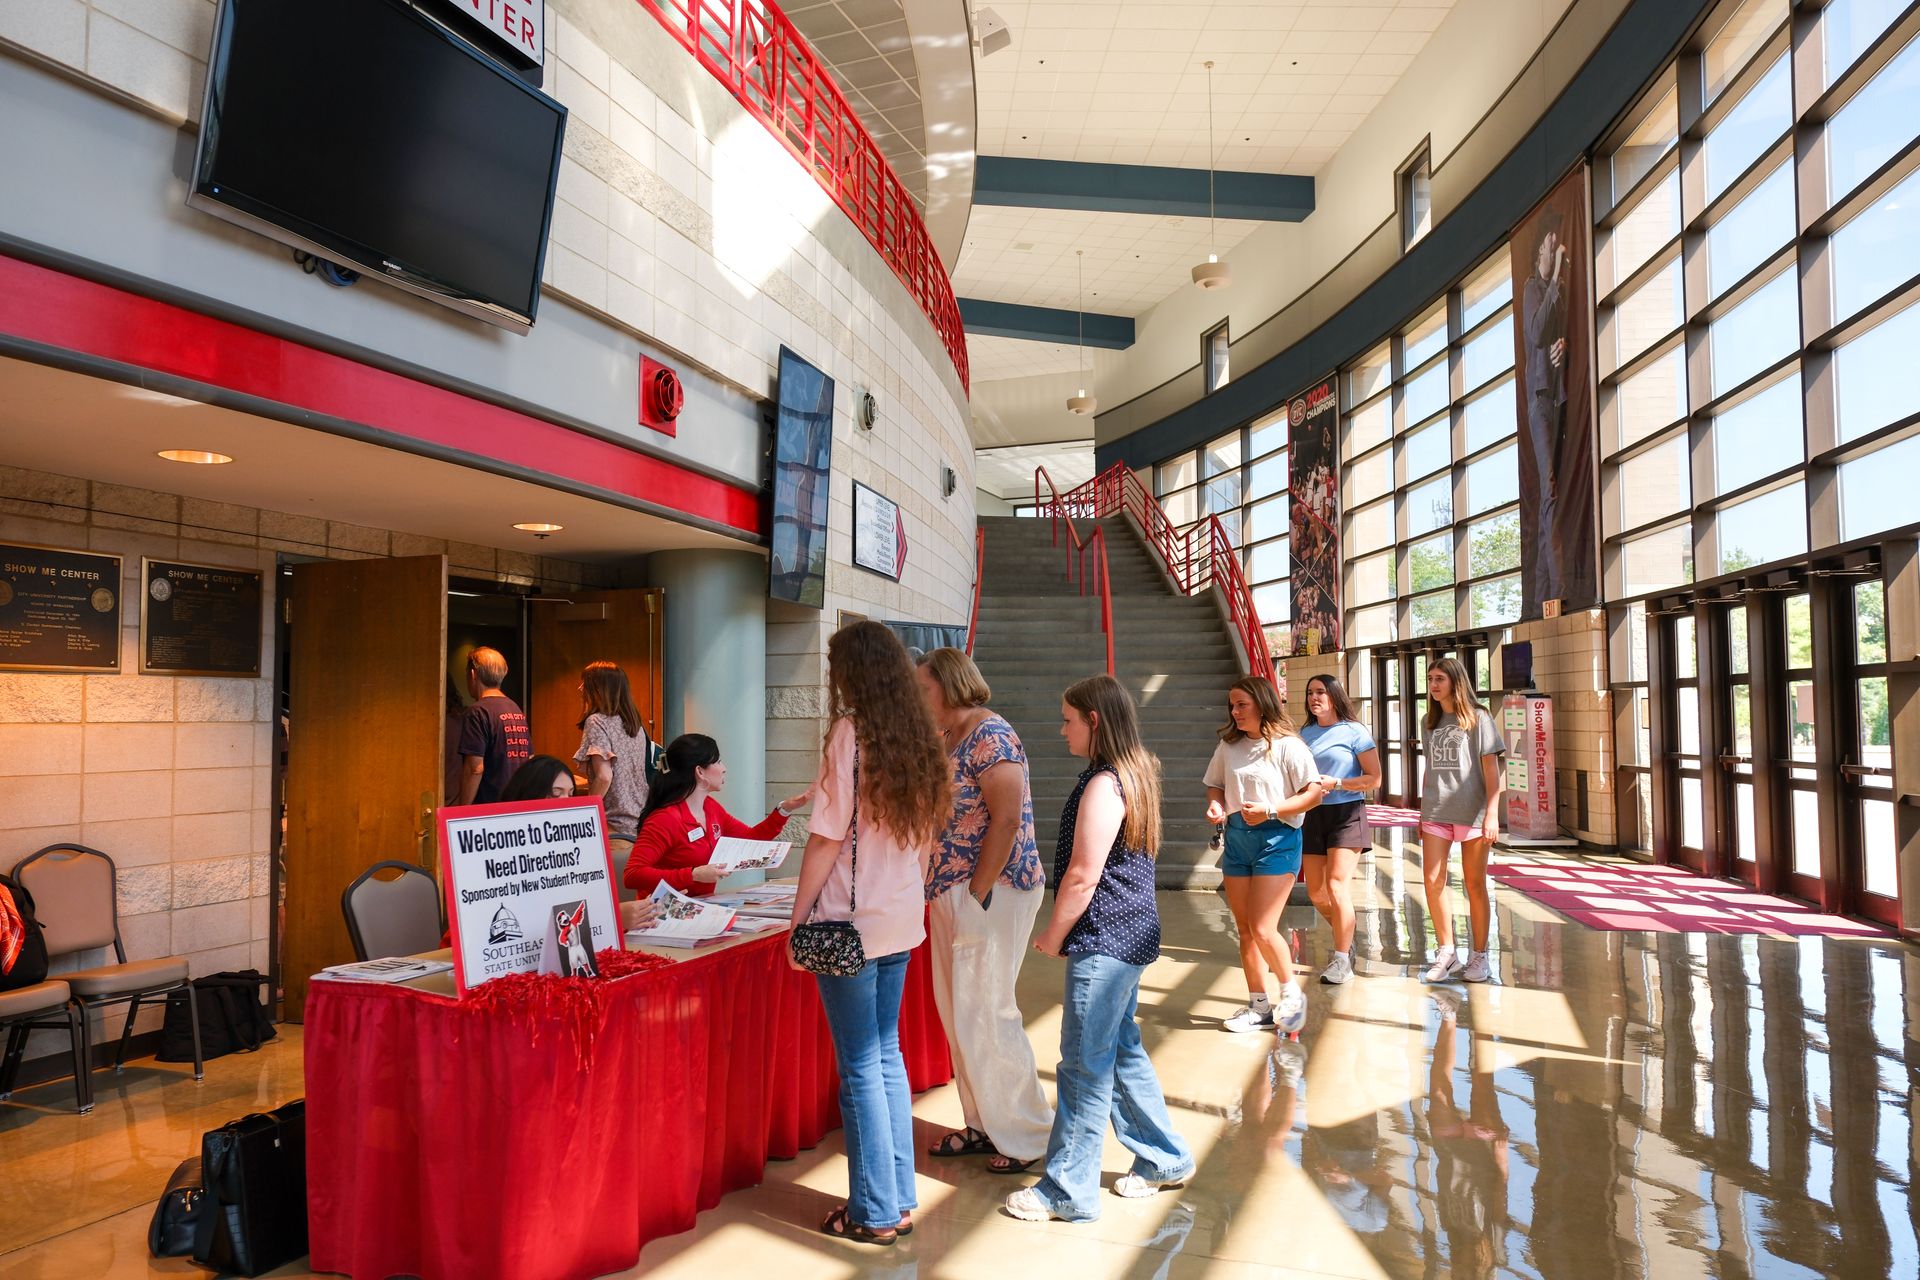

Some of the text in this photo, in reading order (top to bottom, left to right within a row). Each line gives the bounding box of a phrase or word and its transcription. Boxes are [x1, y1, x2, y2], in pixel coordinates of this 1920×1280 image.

[1306, 384, 1329, 409] 2020
[1306, 397, 1336, 420] CHAMPIONS
[4, 563, 100, 581] SHOW ME CENTER
[168, 570, 244, 584] SHOW ME CENTER
[1434, 747, 1460, 762] SIU
[457, 817, 597, 854] Welcome to Campus!
[485, 847, 581, 879] Need Directions?
[461, 869, 605, 905] Sponsored by New Student Programs
[484, 959, 513, 975] STATE
